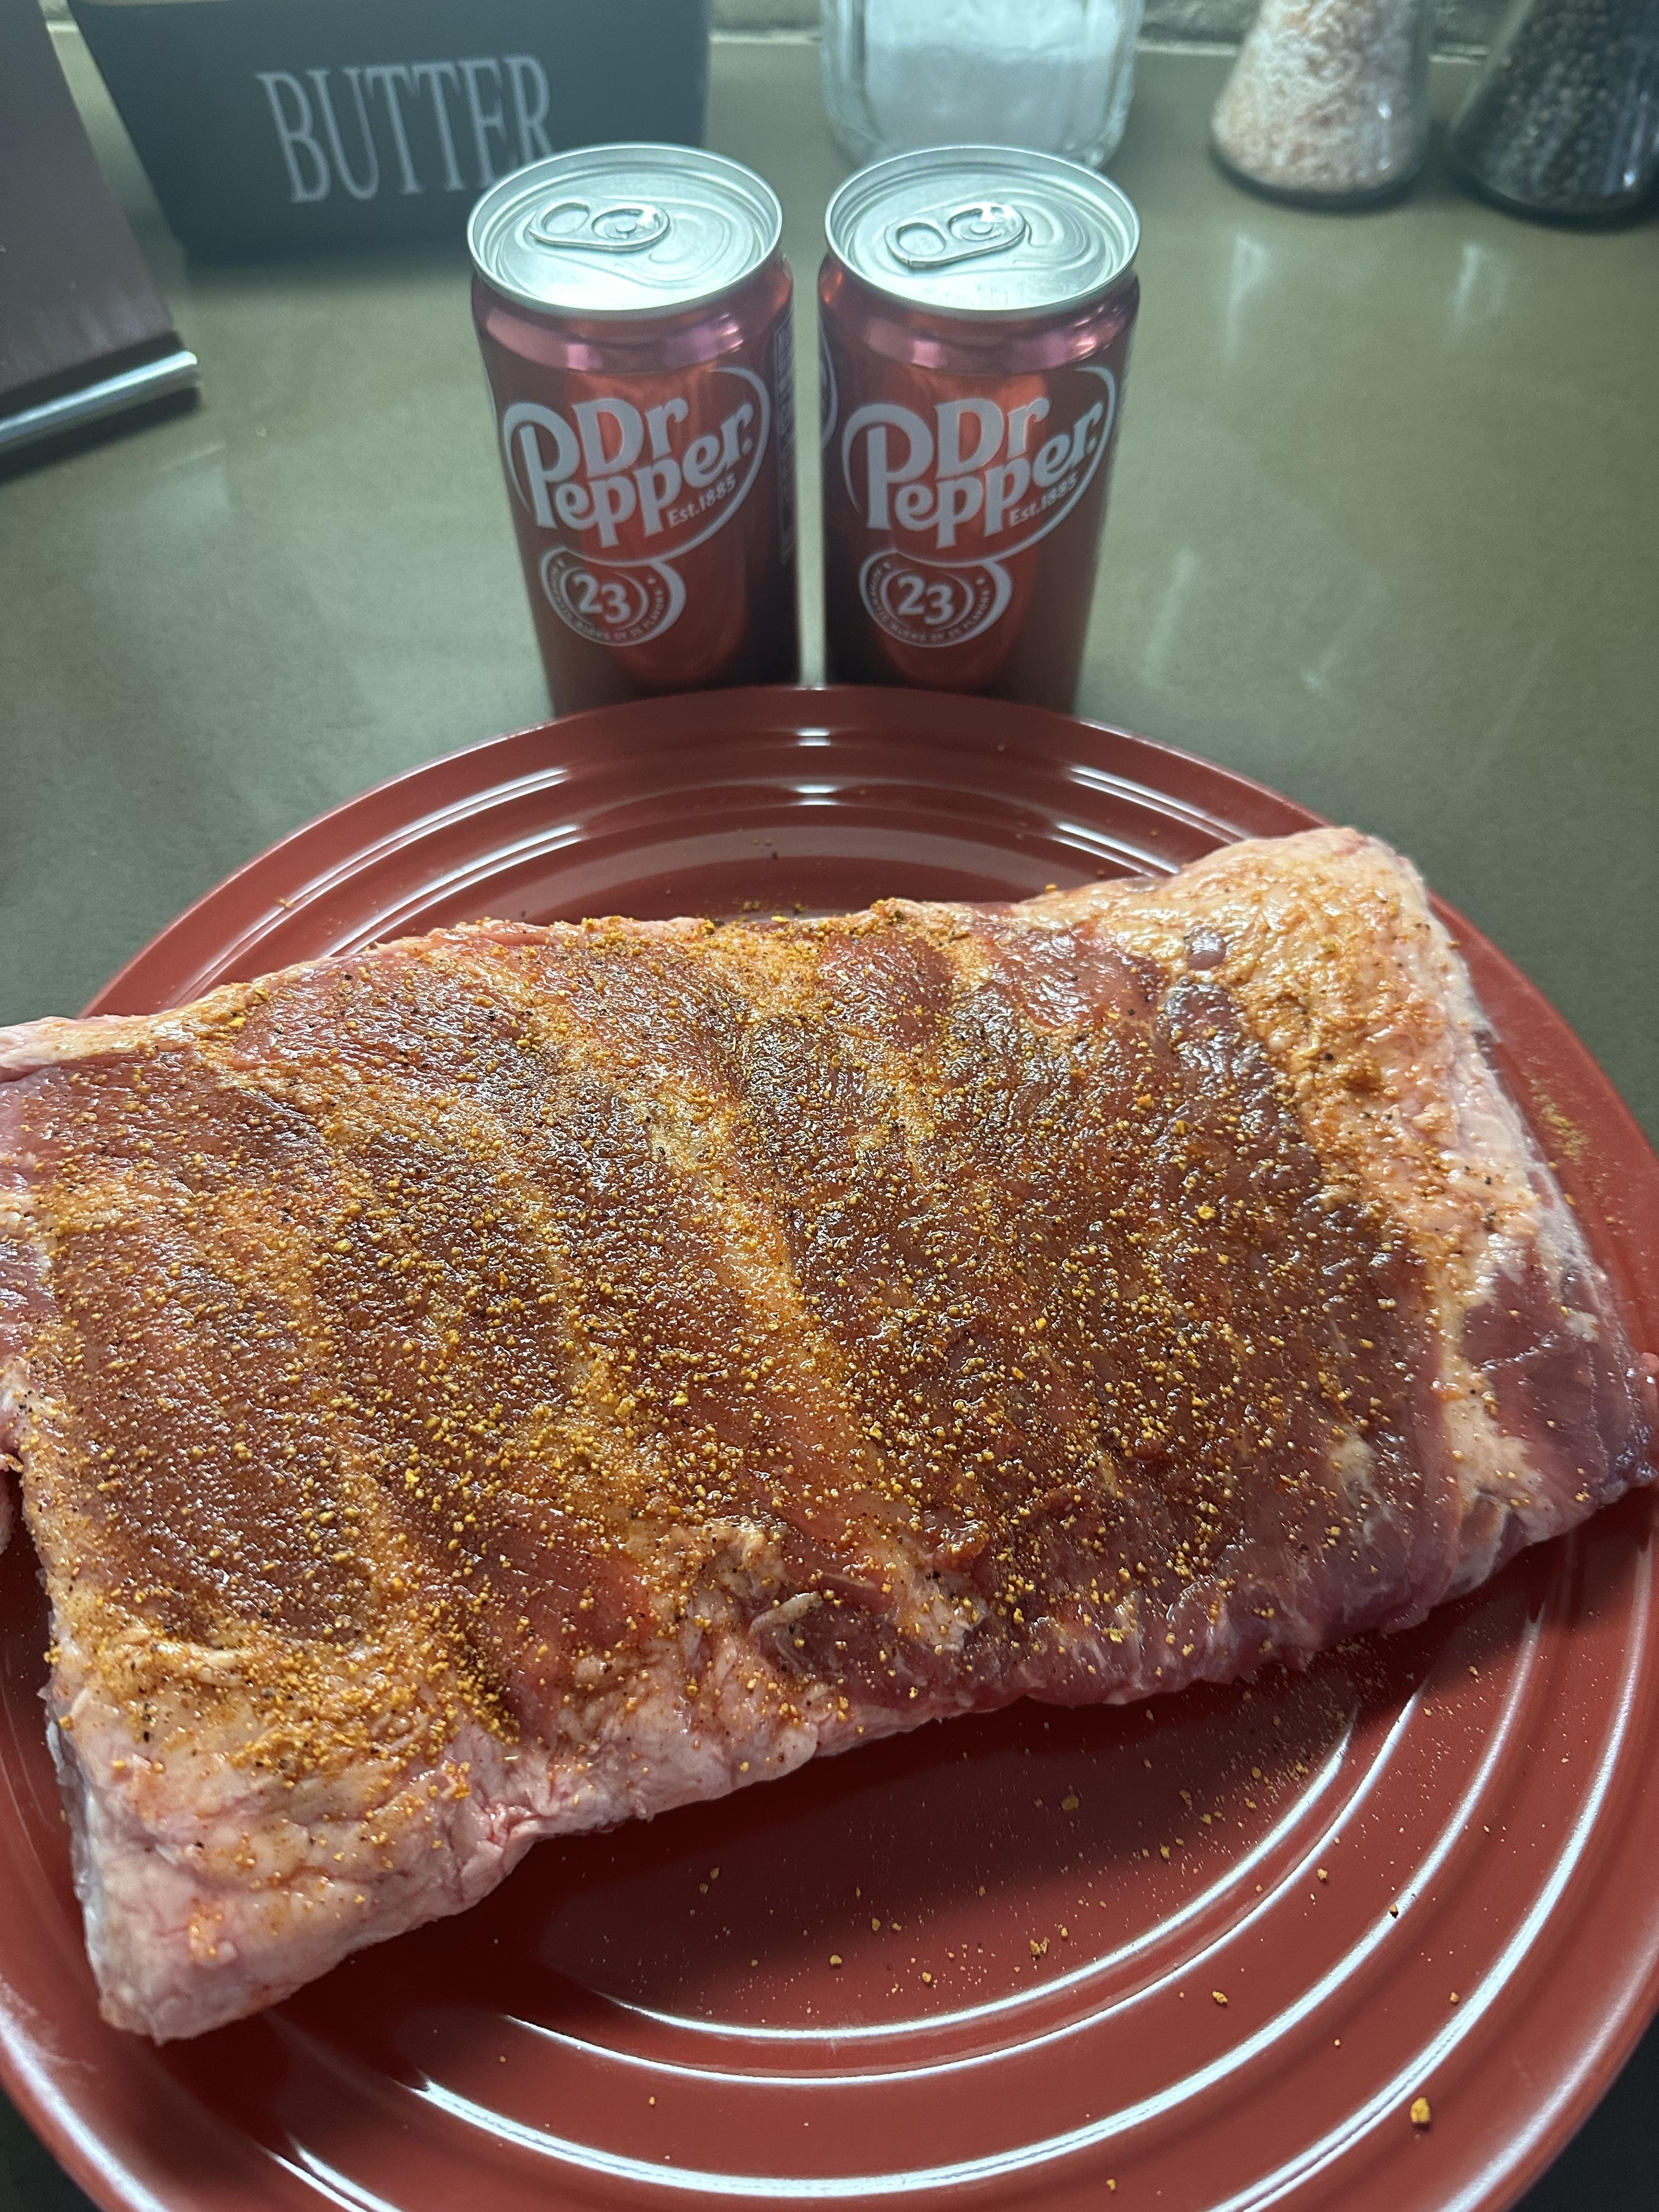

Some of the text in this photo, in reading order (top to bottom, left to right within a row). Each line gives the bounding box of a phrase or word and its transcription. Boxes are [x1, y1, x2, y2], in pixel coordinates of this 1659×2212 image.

[255, 53, 554, 204] BUTTER
[571, 397, 689, 479] Dr
[934, 397, 1051, 479] Dr
[574, 574, 631, 624] 23
[897, 576, 955, 625] 23
